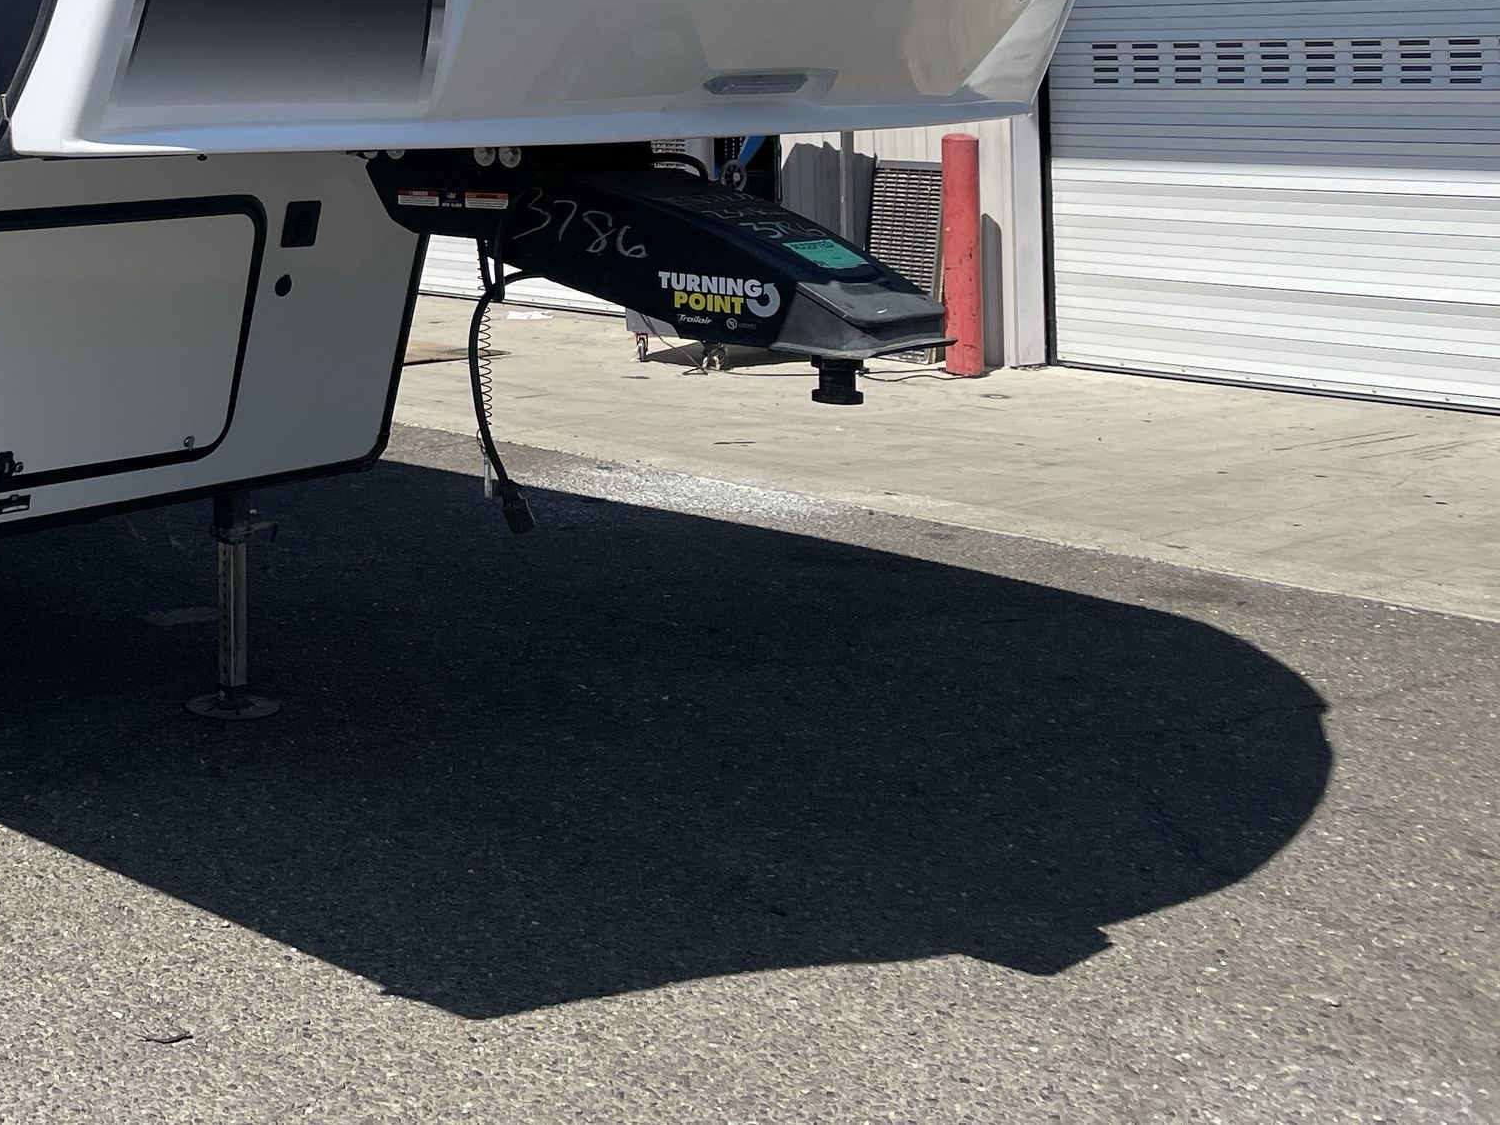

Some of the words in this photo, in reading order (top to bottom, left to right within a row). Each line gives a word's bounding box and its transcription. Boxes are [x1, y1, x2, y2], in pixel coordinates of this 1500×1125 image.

[512, 187, 648, 258] 3786
[658, 270, 763, 298] TURNING
[673, 290, 745, 315] POINT
[676, 313, 713, 325] Trailair
